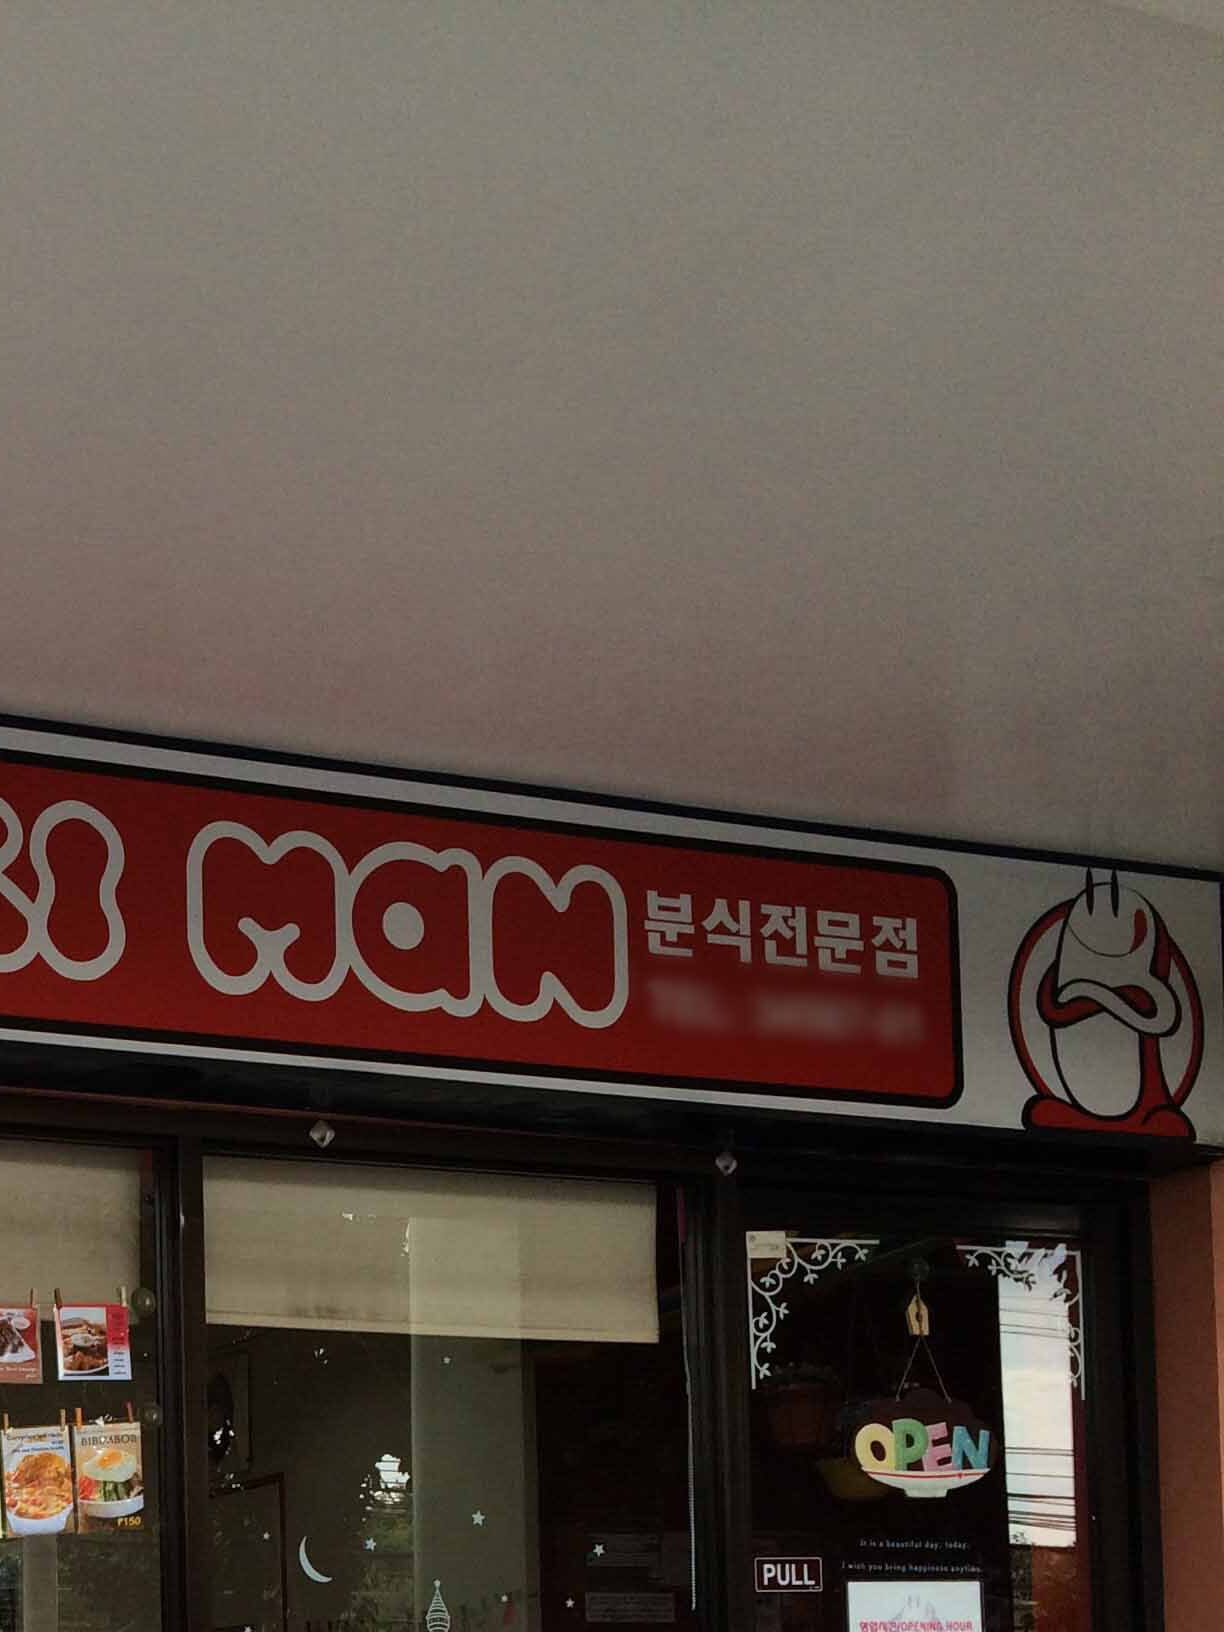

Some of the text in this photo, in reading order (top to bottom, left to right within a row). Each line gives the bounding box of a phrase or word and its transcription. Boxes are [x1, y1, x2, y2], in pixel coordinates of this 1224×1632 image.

[644, 890, 919, 979] 분식전문점
[855, 1418, 990, 1471] OPEN
[763, 1563, 816, 1586] PULL
[868, 1563, 884, 1572] you
[946, 1622, 973, 1632] HOUR
